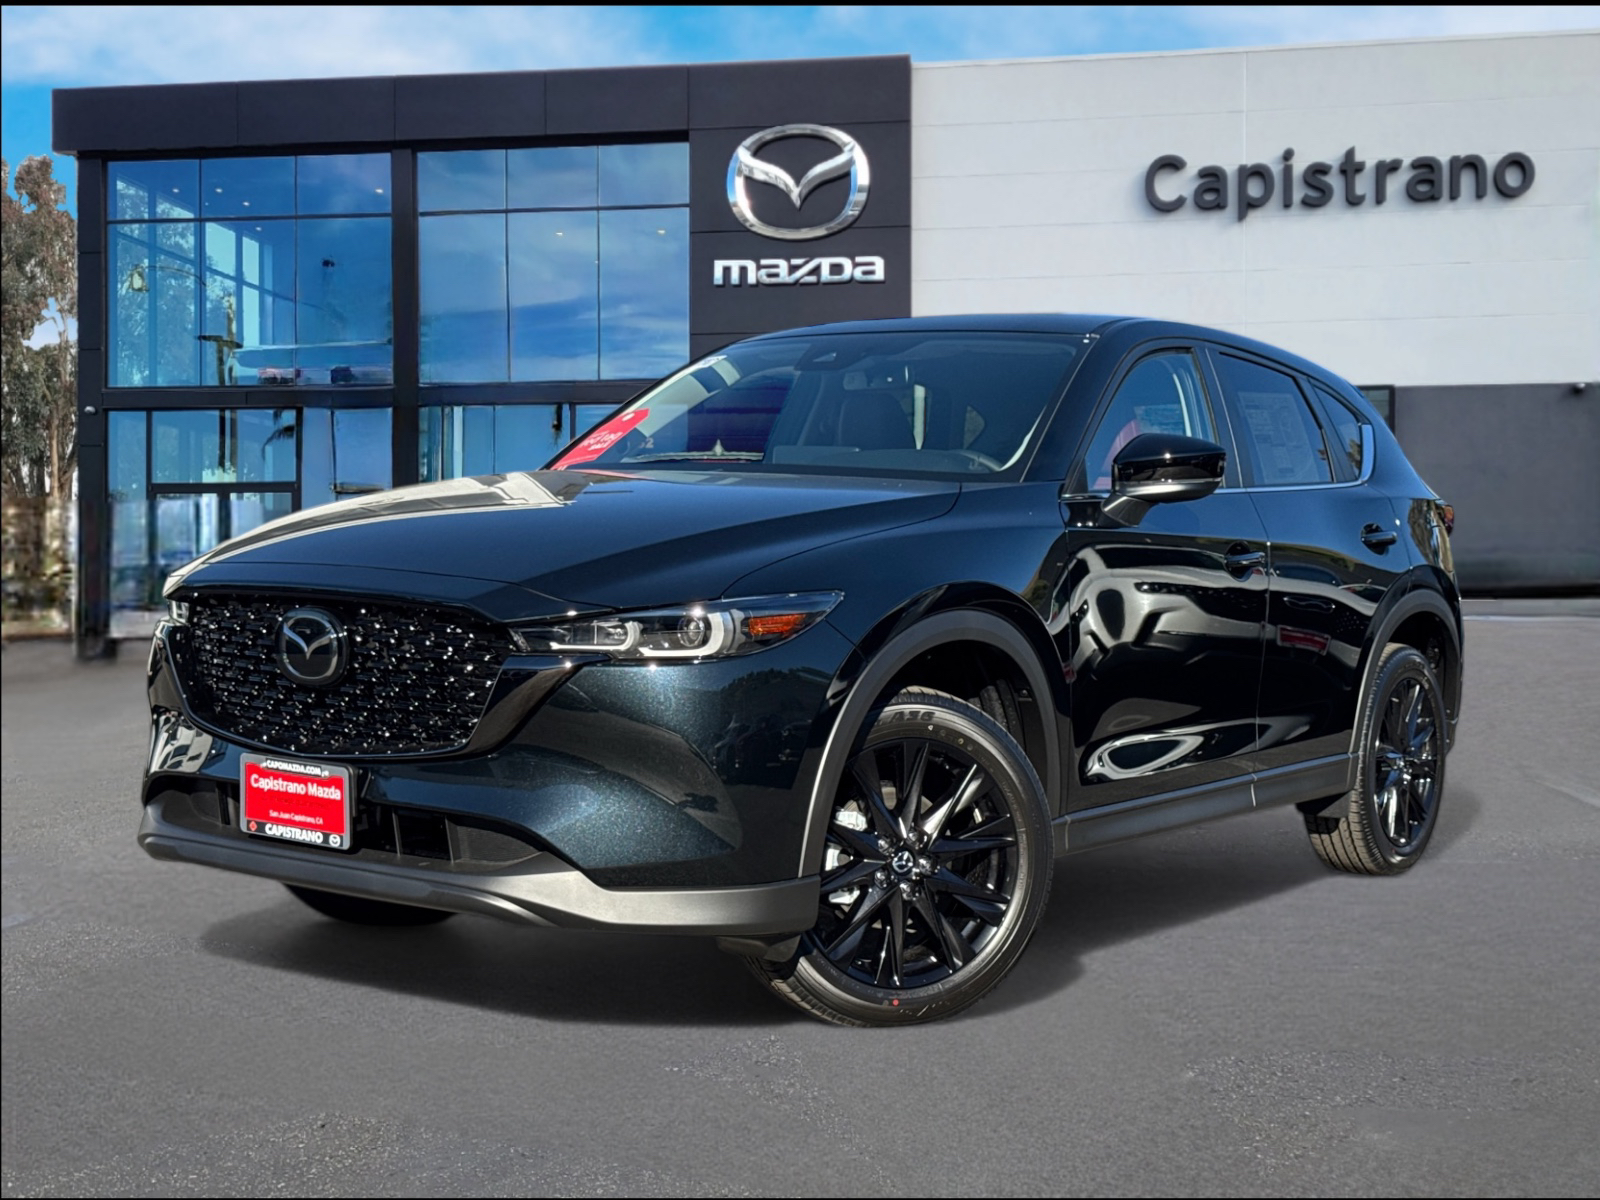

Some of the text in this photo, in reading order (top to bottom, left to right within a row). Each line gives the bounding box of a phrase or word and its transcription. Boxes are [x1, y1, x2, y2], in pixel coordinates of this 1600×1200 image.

[1144, 146, 1535, 222] Capistrano
[250, 773, 341, 800] Capistrano Mazda
[265, 823, 323, 843] CAPISTRANO
